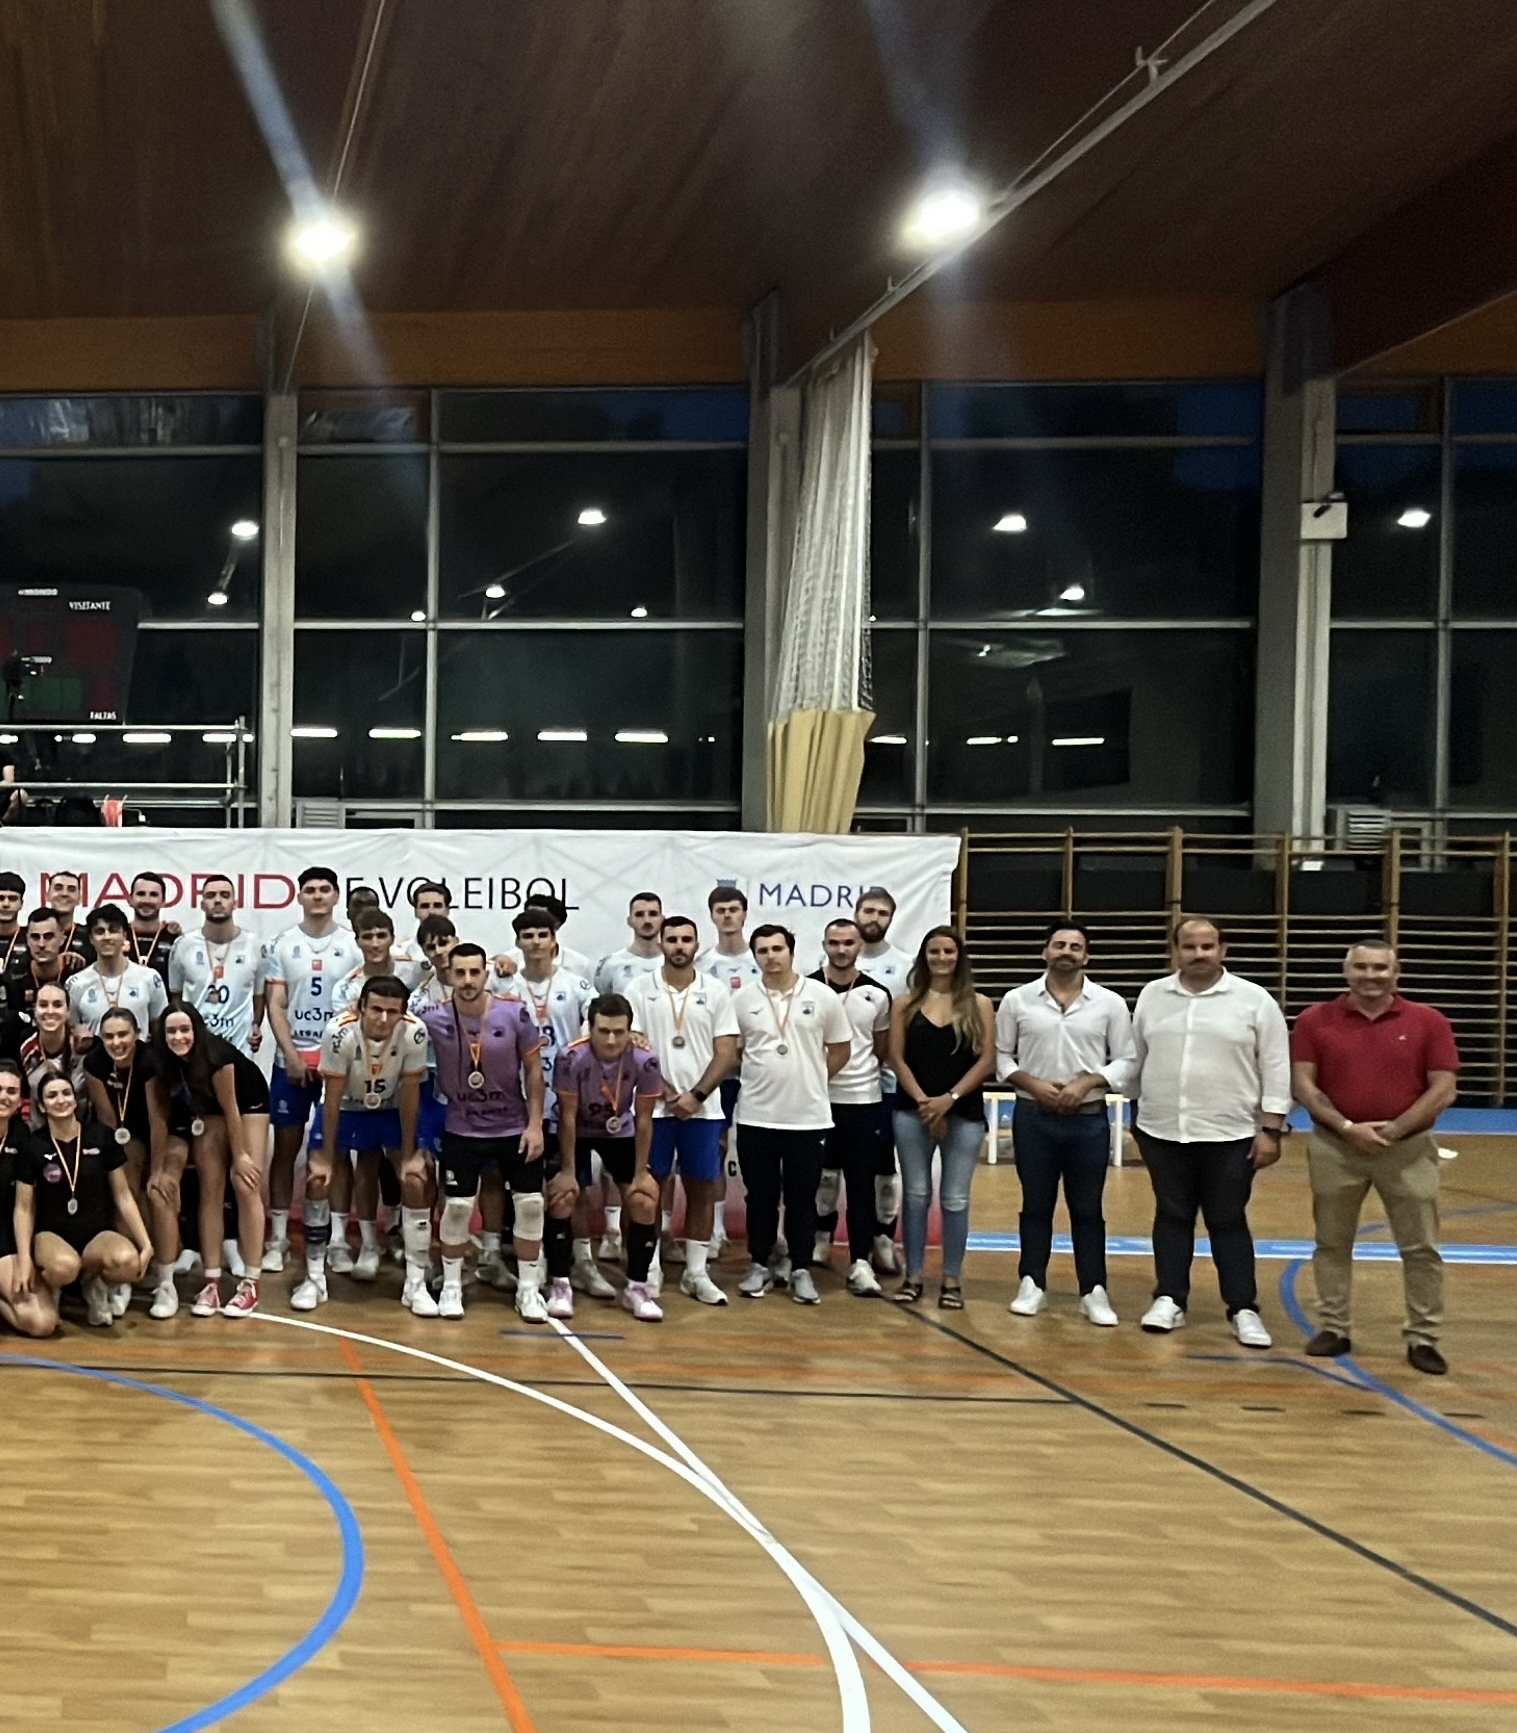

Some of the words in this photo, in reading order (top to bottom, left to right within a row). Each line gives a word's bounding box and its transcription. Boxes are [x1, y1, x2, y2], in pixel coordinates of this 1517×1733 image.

[68, 601, 112, 611] VISITANTE
[90, 711, 117, 721] FALTAS
[378, 876, 580, 910] VOEIBOL
[758, 883, 864, 909] MADR
[310, 977, 323, 996] 5
[364, 1078, 387, 1094] 15
